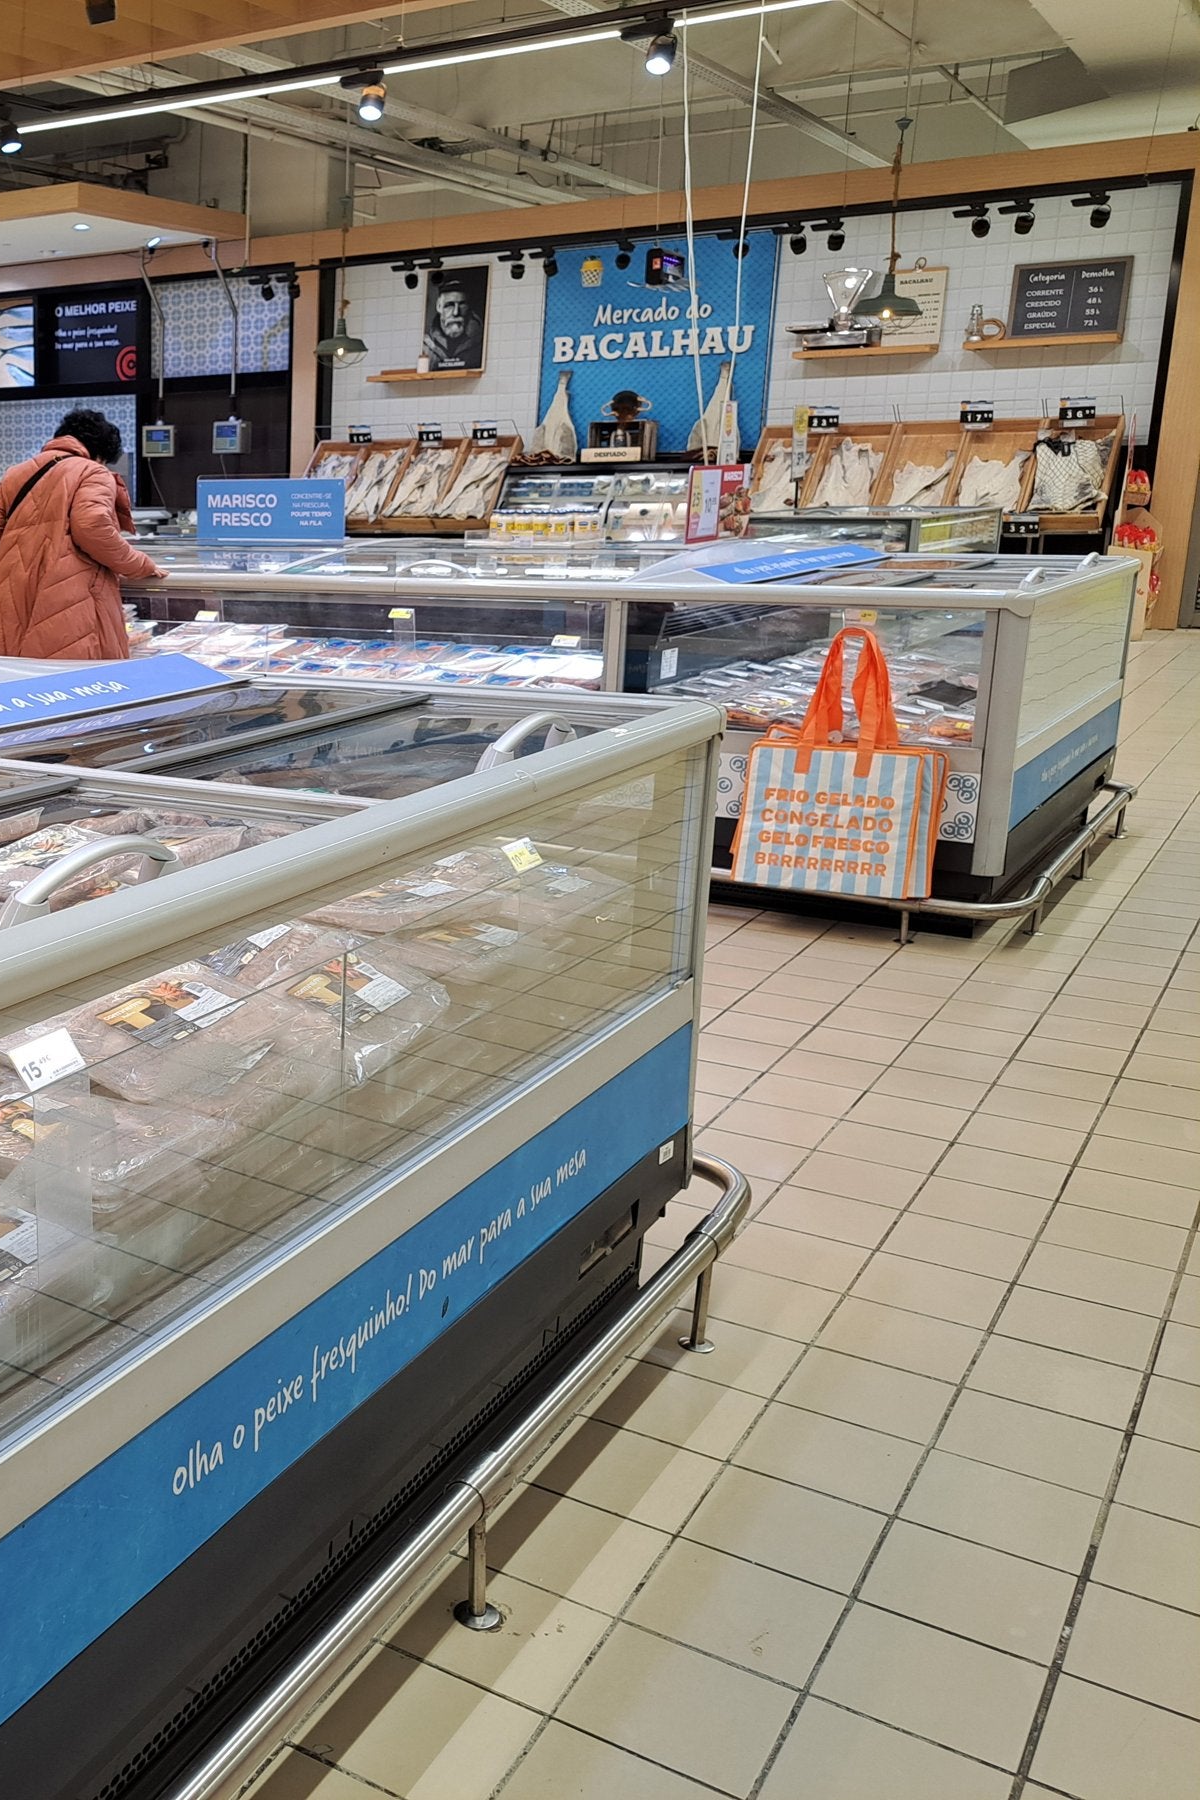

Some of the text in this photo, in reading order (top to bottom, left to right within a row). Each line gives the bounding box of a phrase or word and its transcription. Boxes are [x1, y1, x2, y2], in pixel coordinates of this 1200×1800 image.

[1029, 268, 1115, 284] Categoria Demolha
[1026, 289, 1064, 297] CORRENTE
[55, 300, 137, 317] O MELHOR PEIXE
[594, 295, 712, 327] Mercado do
[1026, 300, 1061, 308] CRESCIDO
[1024, 322, 1056, 330] ESPECIAL
[553, 325, 755, 363] BACALHAU
[208, 494, 277, 508] MARISCO
[212, 512, 272, 527] FRESCO
[11, 697, 34, 709] a
[26, 690, 75, 706] sua
[69, 678, 129, 699] mesa
[764, 788, 895, 811] FRIO GELADO
[760, 808, 893, 833] CONGELADO
[758, 830, 890, 855] GELO FRESCO
[172, 1149, 586, 1495] olha o peixe fresquinho! Do mar para a sua mesa
